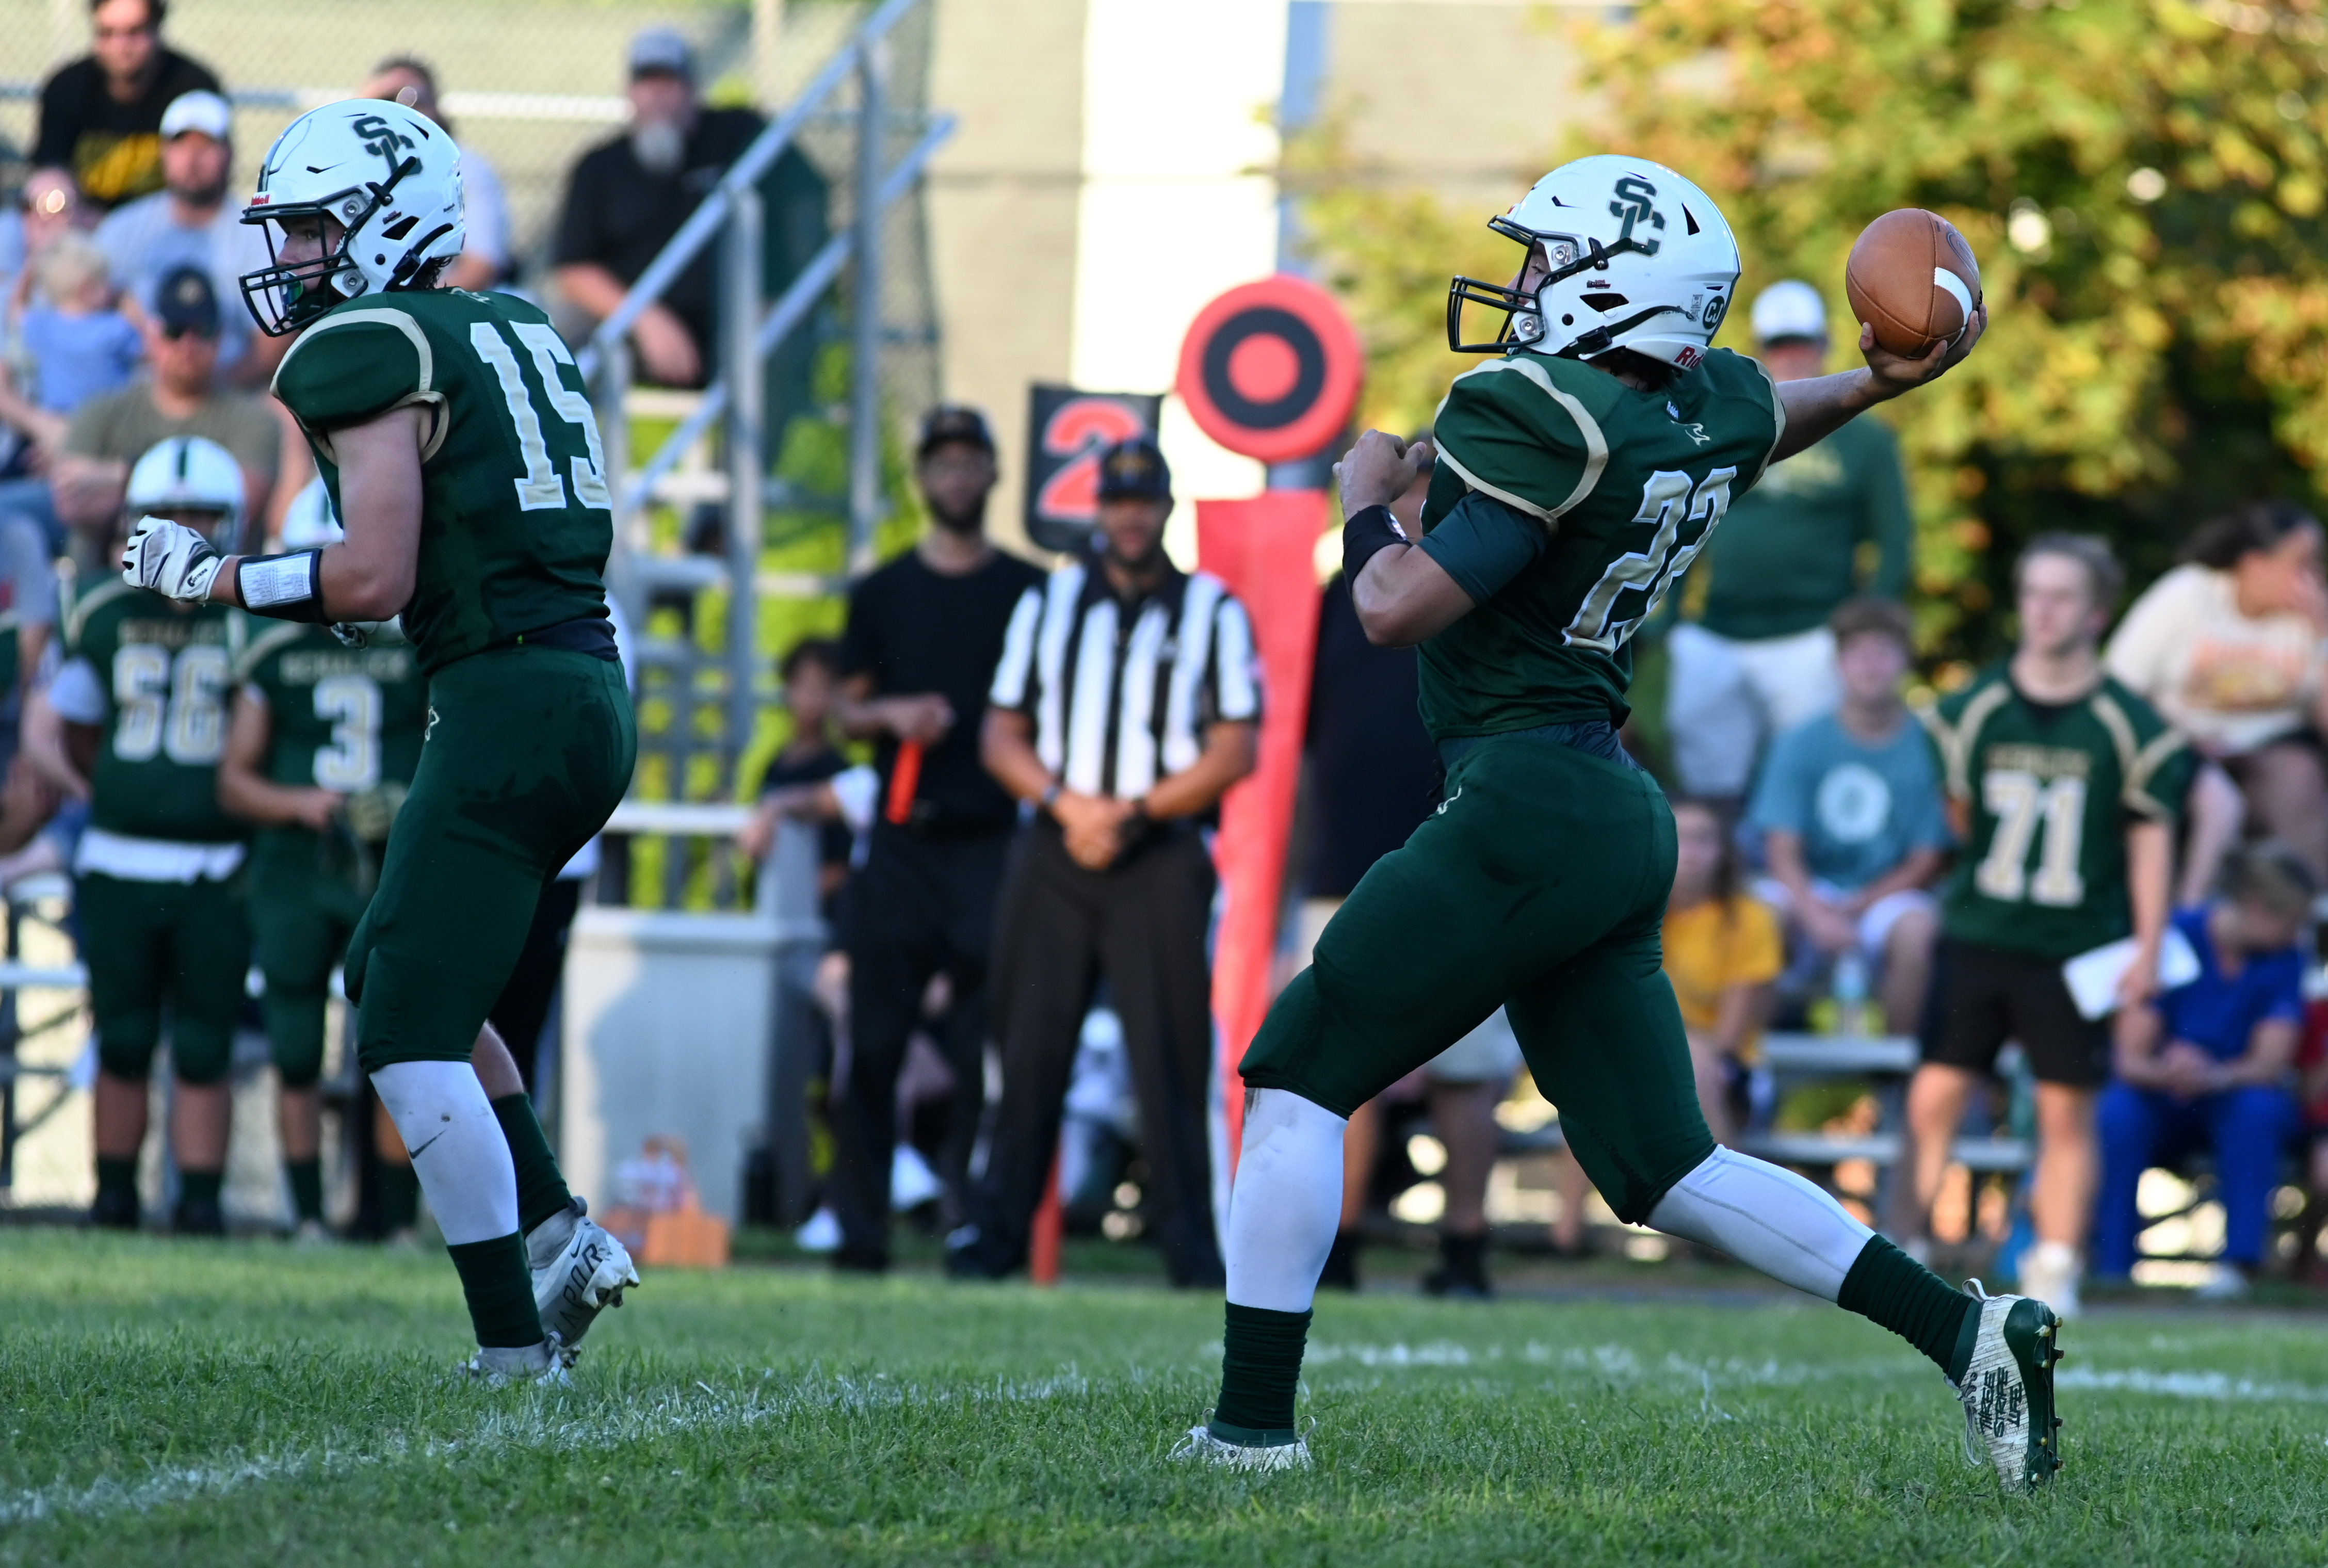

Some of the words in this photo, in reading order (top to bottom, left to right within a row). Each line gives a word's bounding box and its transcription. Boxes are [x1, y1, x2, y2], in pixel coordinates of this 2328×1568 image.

[1674, 346, 1705, 370] Rid
[1704, 302, 1724, 324] CJ
[470, 320, 612, 511] 15
[1035, 397, 1144, 522] 2
[1561, 465, 1737, 657] 22
[111, 643, 228, 765] 56
[312, 674, 384, 792] 3
[1974, 771, 2088, 908] 71
